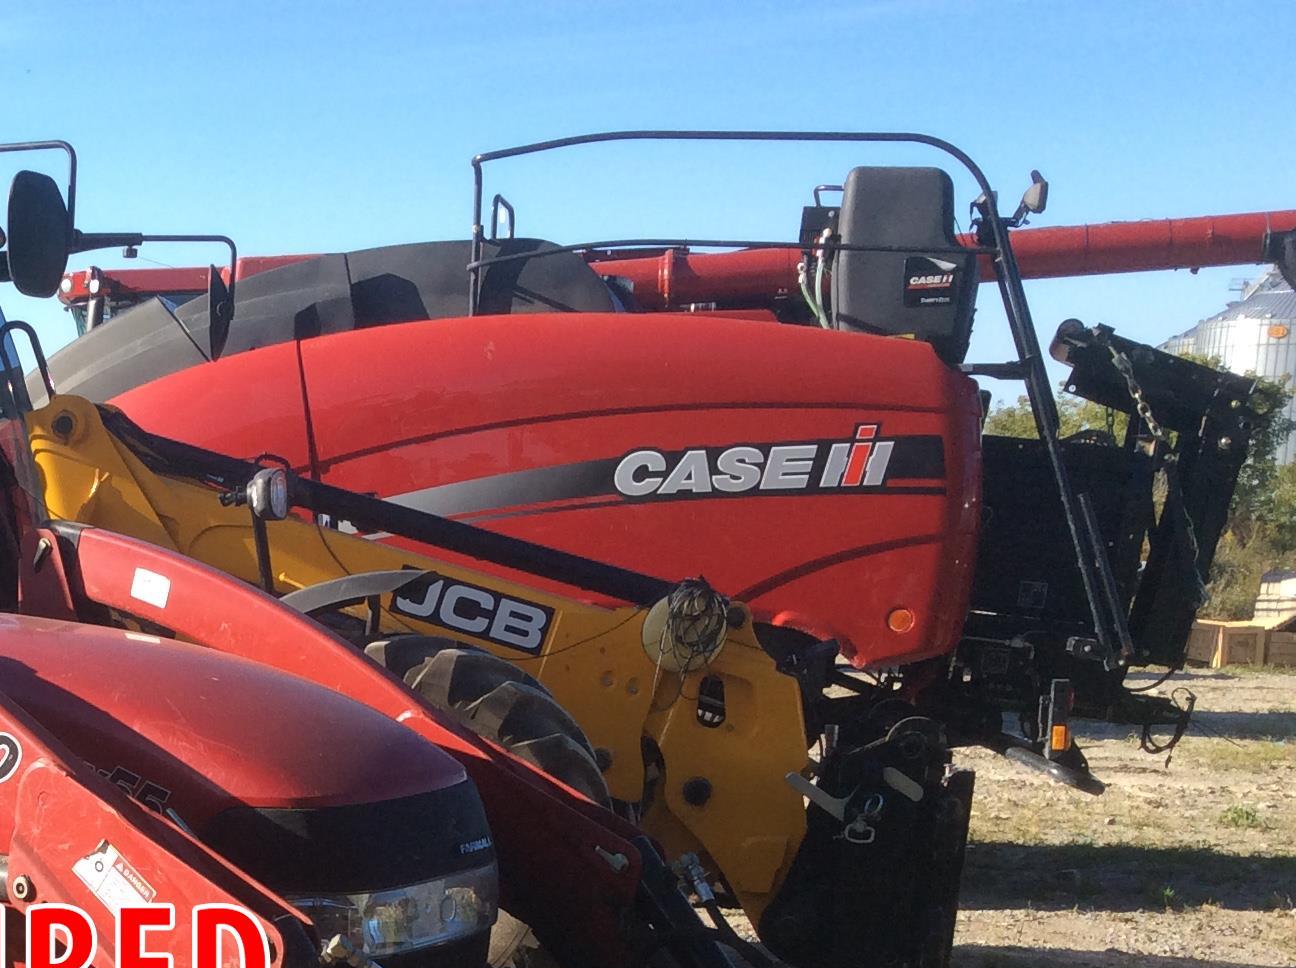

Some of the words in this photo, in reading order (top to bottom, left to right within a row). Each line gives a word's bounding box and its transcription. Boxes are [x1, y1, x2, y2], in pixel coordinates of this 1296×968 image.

[909, 275, 942, 285] CASE
[614, 447, 818, 496] CASE
[396, 579, 547, 649] JCB
[122, 868, 151, 899] DANGER
